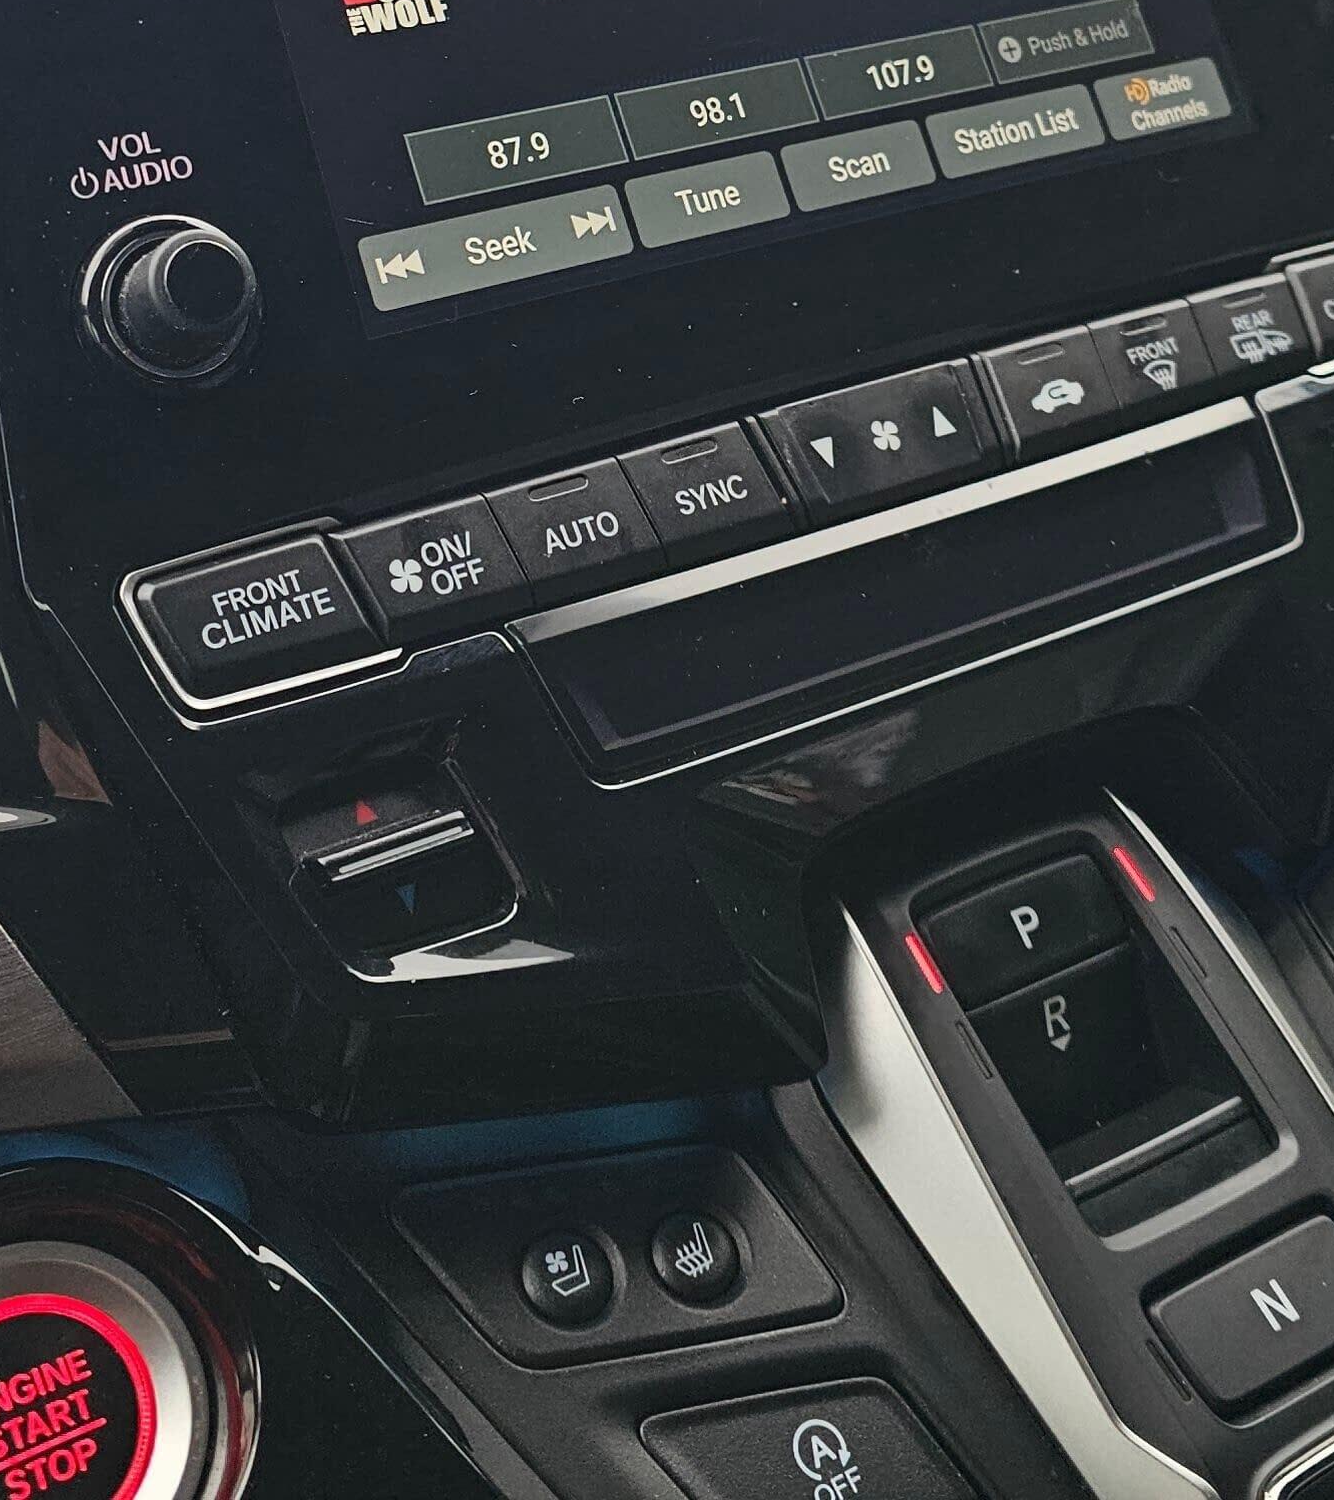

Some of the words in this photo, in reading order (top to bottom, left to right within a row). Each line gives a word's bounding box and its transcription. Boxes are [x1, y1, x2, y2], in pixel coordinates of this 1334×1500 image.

[347, 7, 365, 36] THE
[1026, 31, 1071, 56] Push
[1074, 28, 1088, 45] &
[1089, 19, 1130, 42] Hold
[866, 54, 935, 91] 107.9
[1149, 72, 1194, 97] Radio
[689, 92, 747, 128] 98.1
[1131, 98, 1209, 131] Channels
[97, 130, 161, 161] VOL
[954, 120, 1035, 155] Station
[1036, 108, 1080, 137] List
[487, 132, 550, 169] 87.9
[828, 150, 891, 182] Scan
[103, 155, 193, 193] AUDIO
[674, 184, 741, 217] Tune
[464, 225, 538, 266] Seek
[1231, 308, 1275, 333] REAR
[1126, 335, 1180, 365] FRONT
[674, 474, 749, 516] SYNC
[420, 531, 472, 569] ON/
[543, 511, 620, 556] AUTO
[211, 568, 303, 616] FRONT
[431, 557, 485, 596] OFF
[201, 587, 336, 651] CLIMATE
[1010, 906, 1040, 949] P
[1043, 995, 1071, 1038] R
[1250, 1279, 1300, 1332] N
[4, 1438, 98, 1500] STOP
[814, 1466, 862, 1500] OFF
